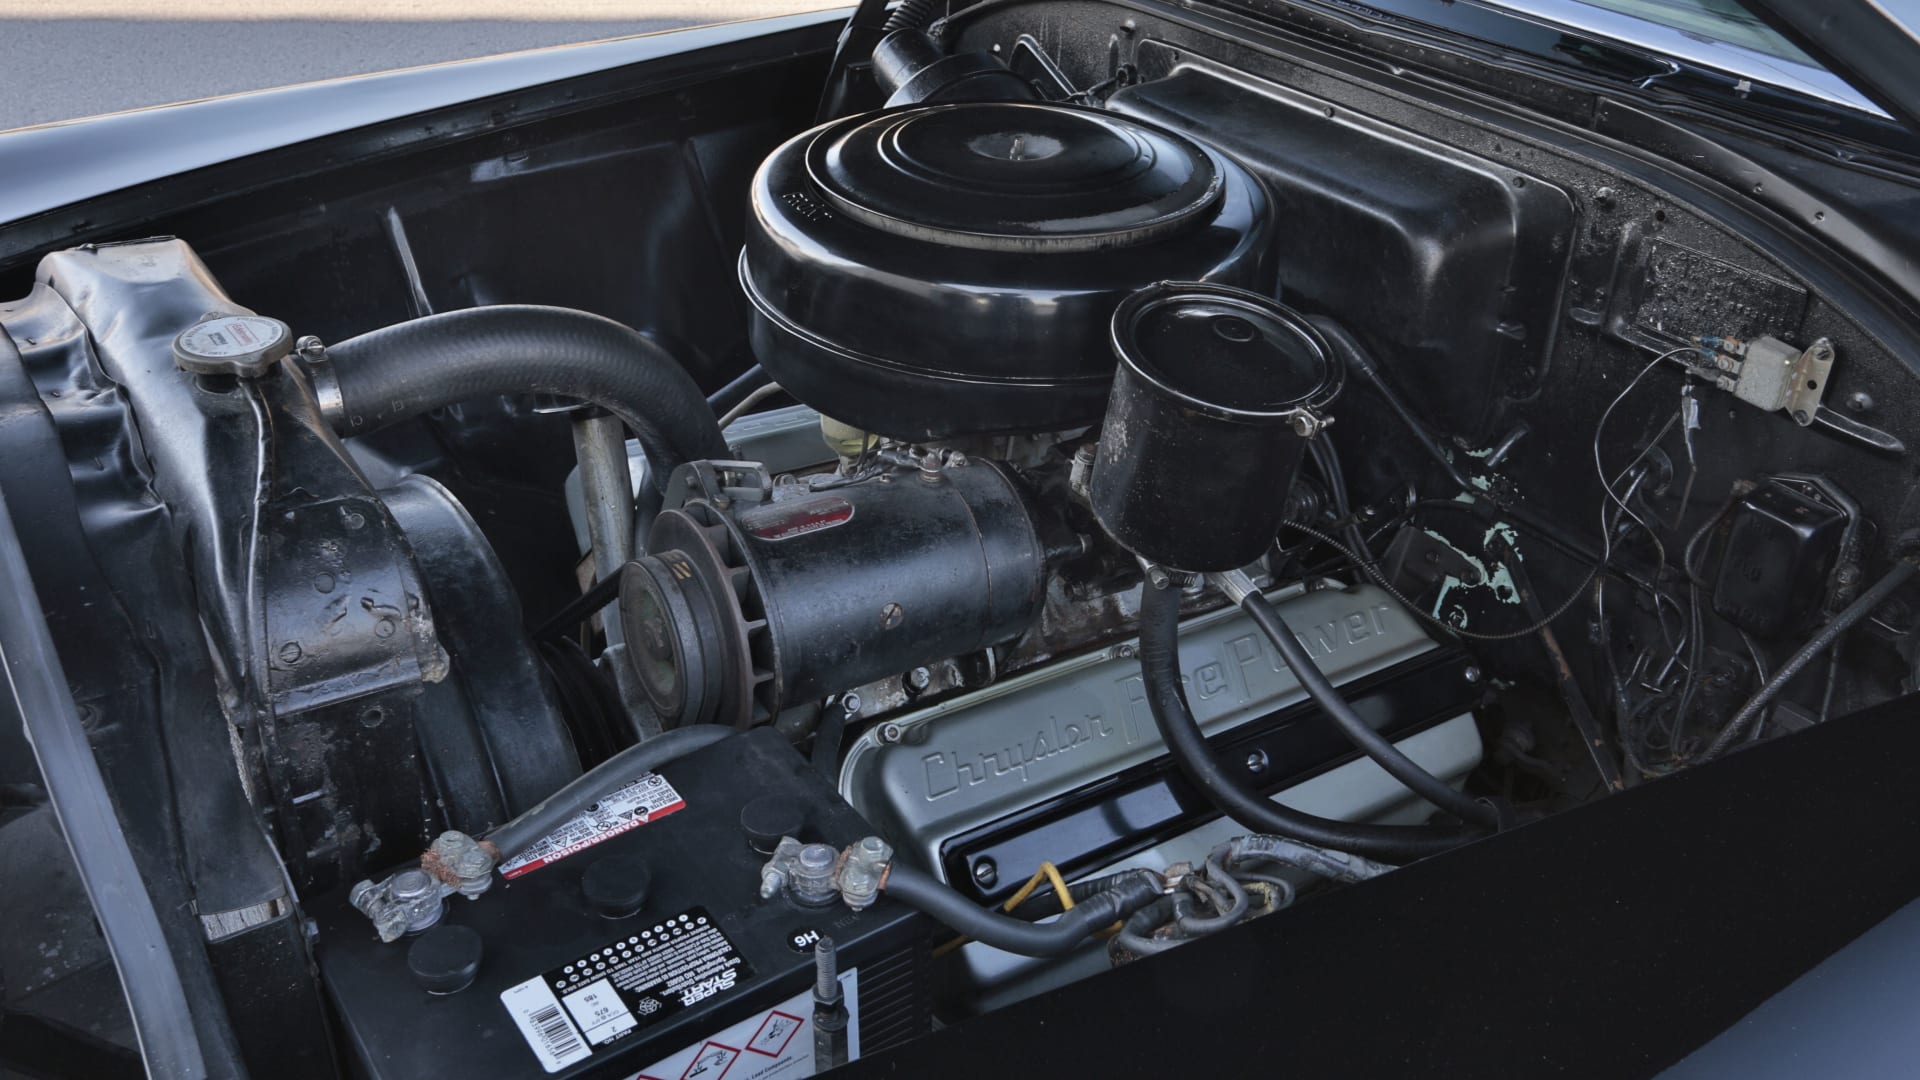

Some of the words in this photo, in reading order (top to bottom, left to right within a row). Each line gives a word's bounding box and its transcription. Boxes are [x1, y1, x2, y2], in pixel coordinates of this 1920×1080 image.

[781, 191, 833, 221] FRONT
[920, 712, 1114, 802] Chrysler
[1113, 600, 1391, 746] FePower
[542, 820, 639, 864] DANGER/POISON
[583, 993, 597, 1002] 185
[681, 968, 737, 1000] START
[684, 980, 735, 1006] SUPER
[594, 1007, 609, 1017] 675
[615, 1028, 632, 1039] PART
